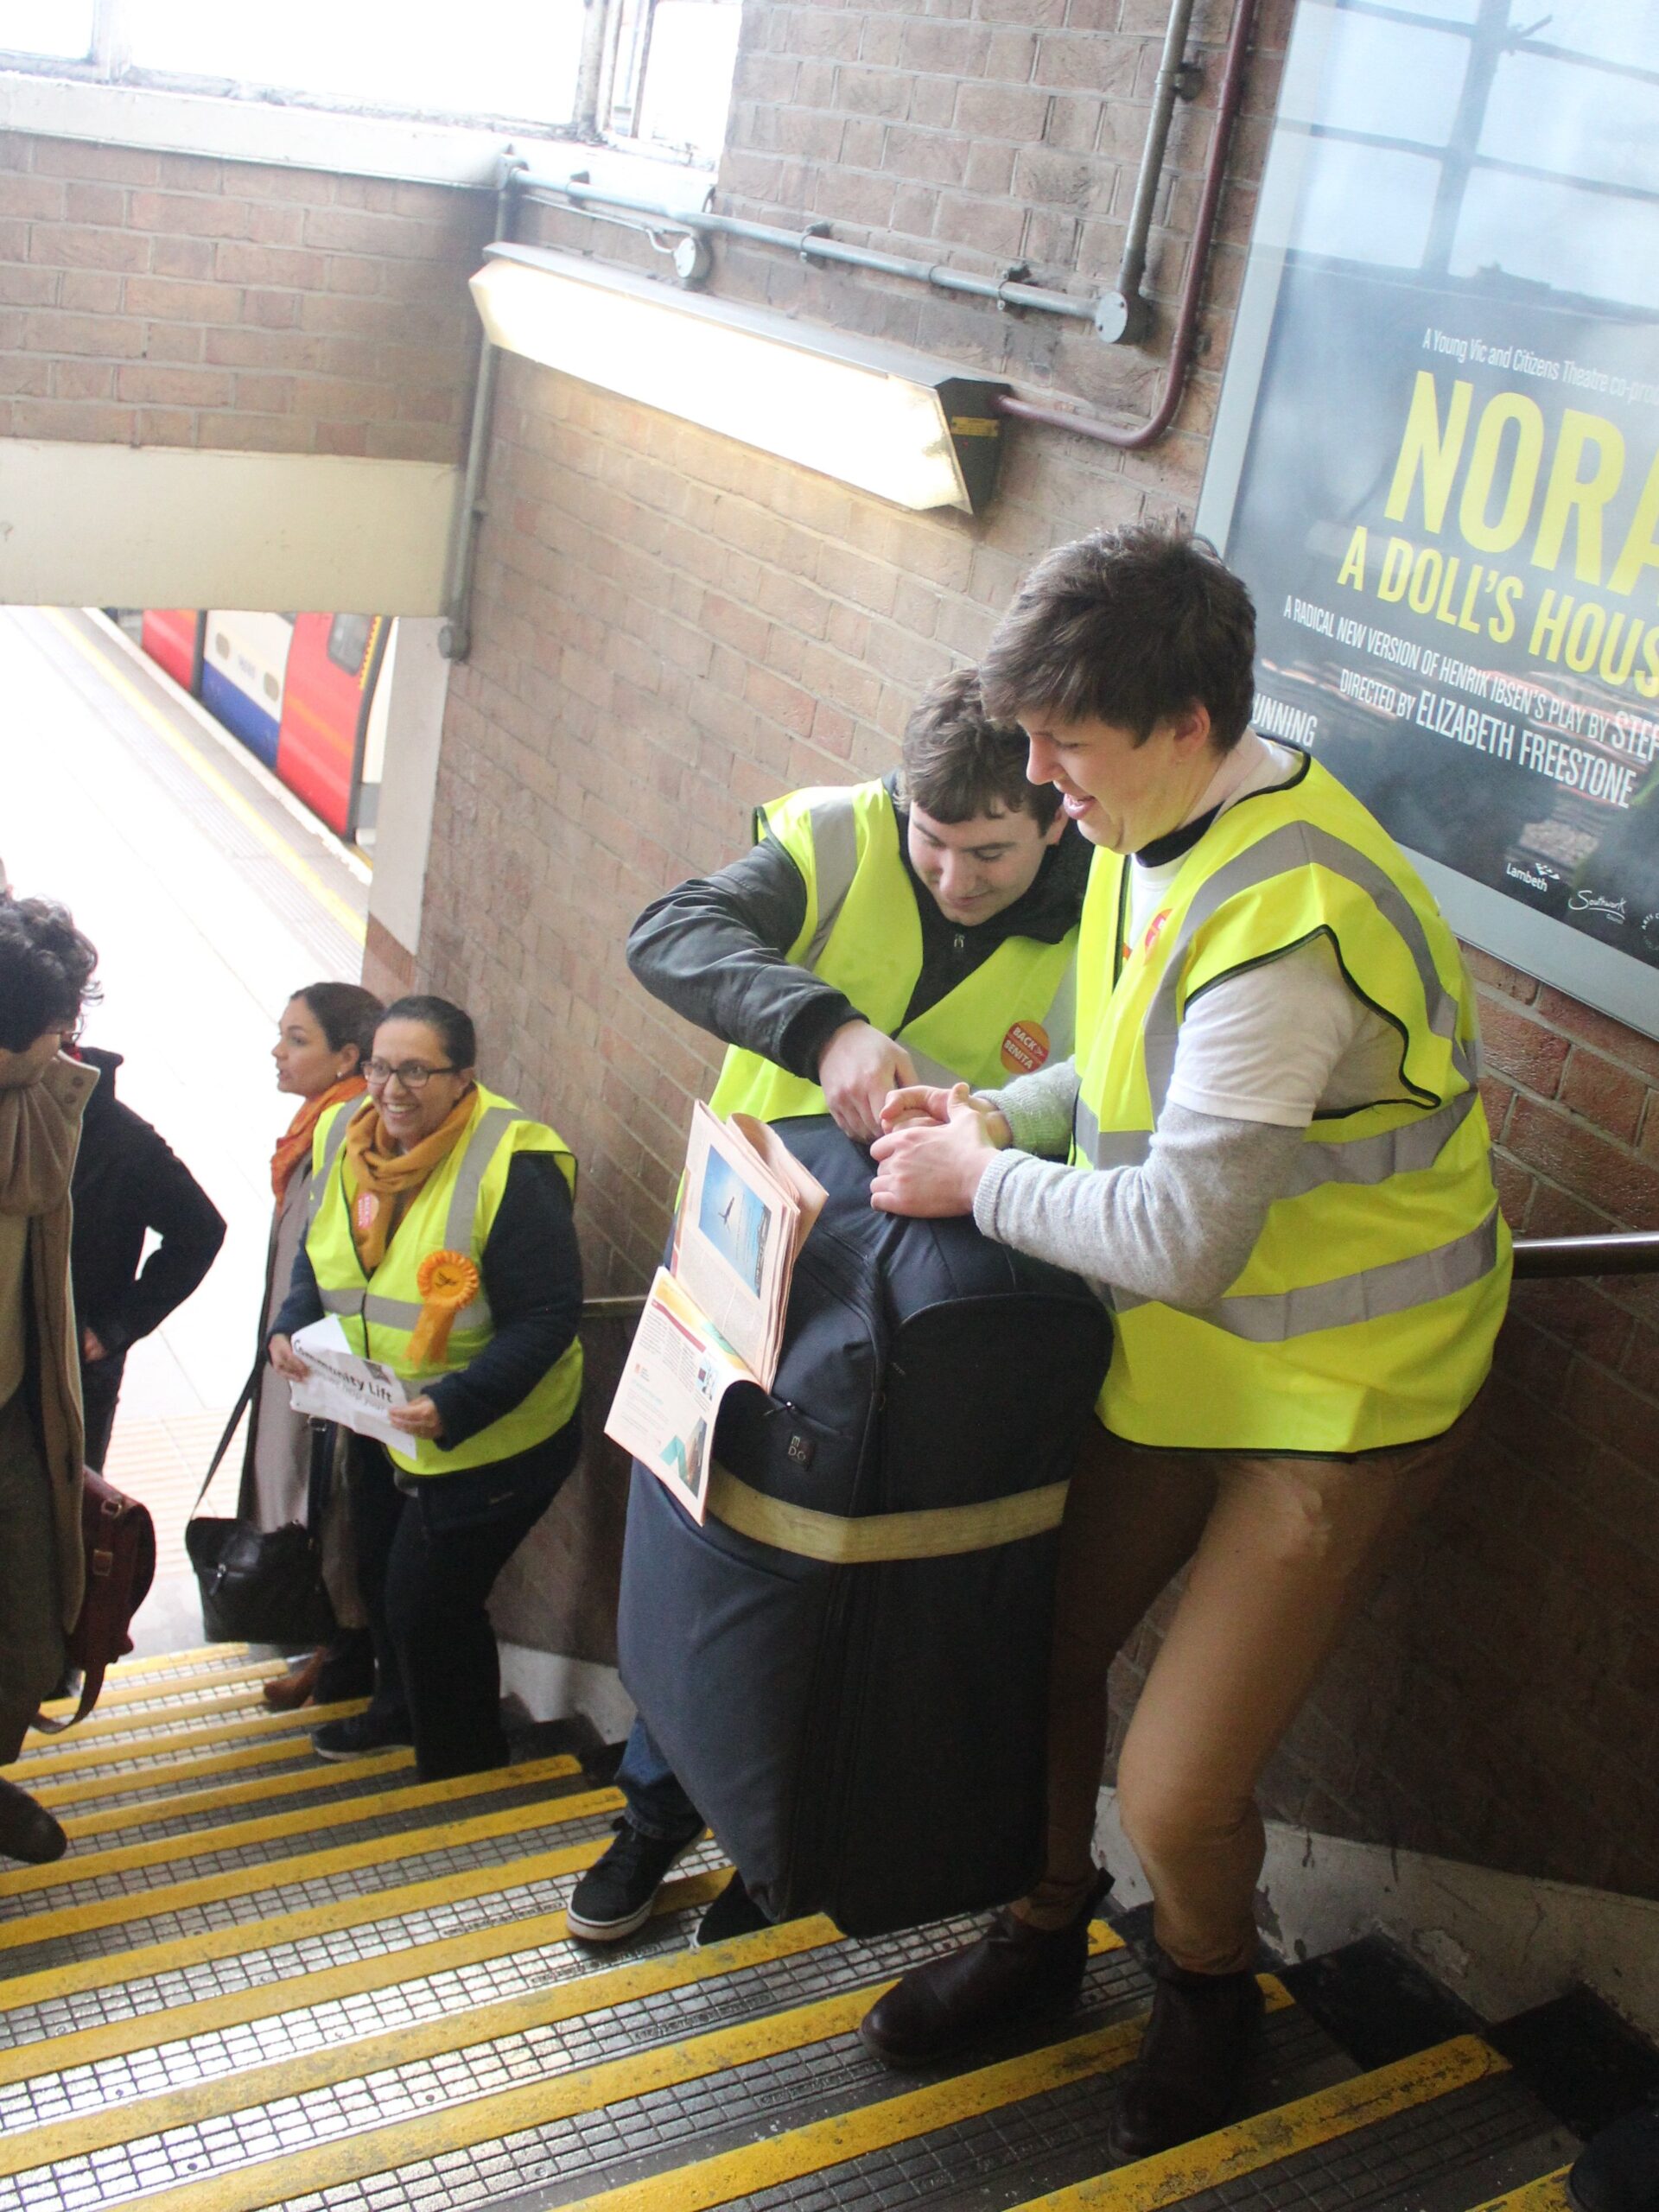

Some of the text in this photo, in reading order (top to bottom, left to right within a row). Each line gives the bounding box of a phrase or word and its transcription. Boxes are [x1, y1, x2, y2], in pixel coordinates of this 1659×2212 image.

[1422, 327, 1432, 349] A
[1433, 329, 1468, 364] Young
[1471, 338, 1487, 363] Vic
[1488, 346, 1512, 369] and
[1512, 349, 1561, 381] Citizens
[1562, 359, 1609, 392] Theatre
[1337, 525, 1368, 592] A
[1376, 537, 1524, 644] DOLL'S
[1283, 594, 1292, 619] A
[1294, 598, 1335, 639] RADICAL
[1336, 616, 1367, 649] NEW
[1367, 627, 1422, 671] VERSION
[1421, 649, 1440, 677] OF
[1439, 656, 1491, 698] HENRIK
[1490, 676, 1547, 720] IBSEN'S
[1548, 697, 1586, 734] PLAY
[1587, 713, 1610, 743] BY
[1339, 668, 1637, 810] DIRECTED BY ELIZABETH FREESTONE
[1506, 862, 1548, 893] Lambeth
[1003, 1039, 1034, 1070] BENITA
[1013, 1027, 1037, 1052] BACK
[369, 1382, 392, 1403] Lift
